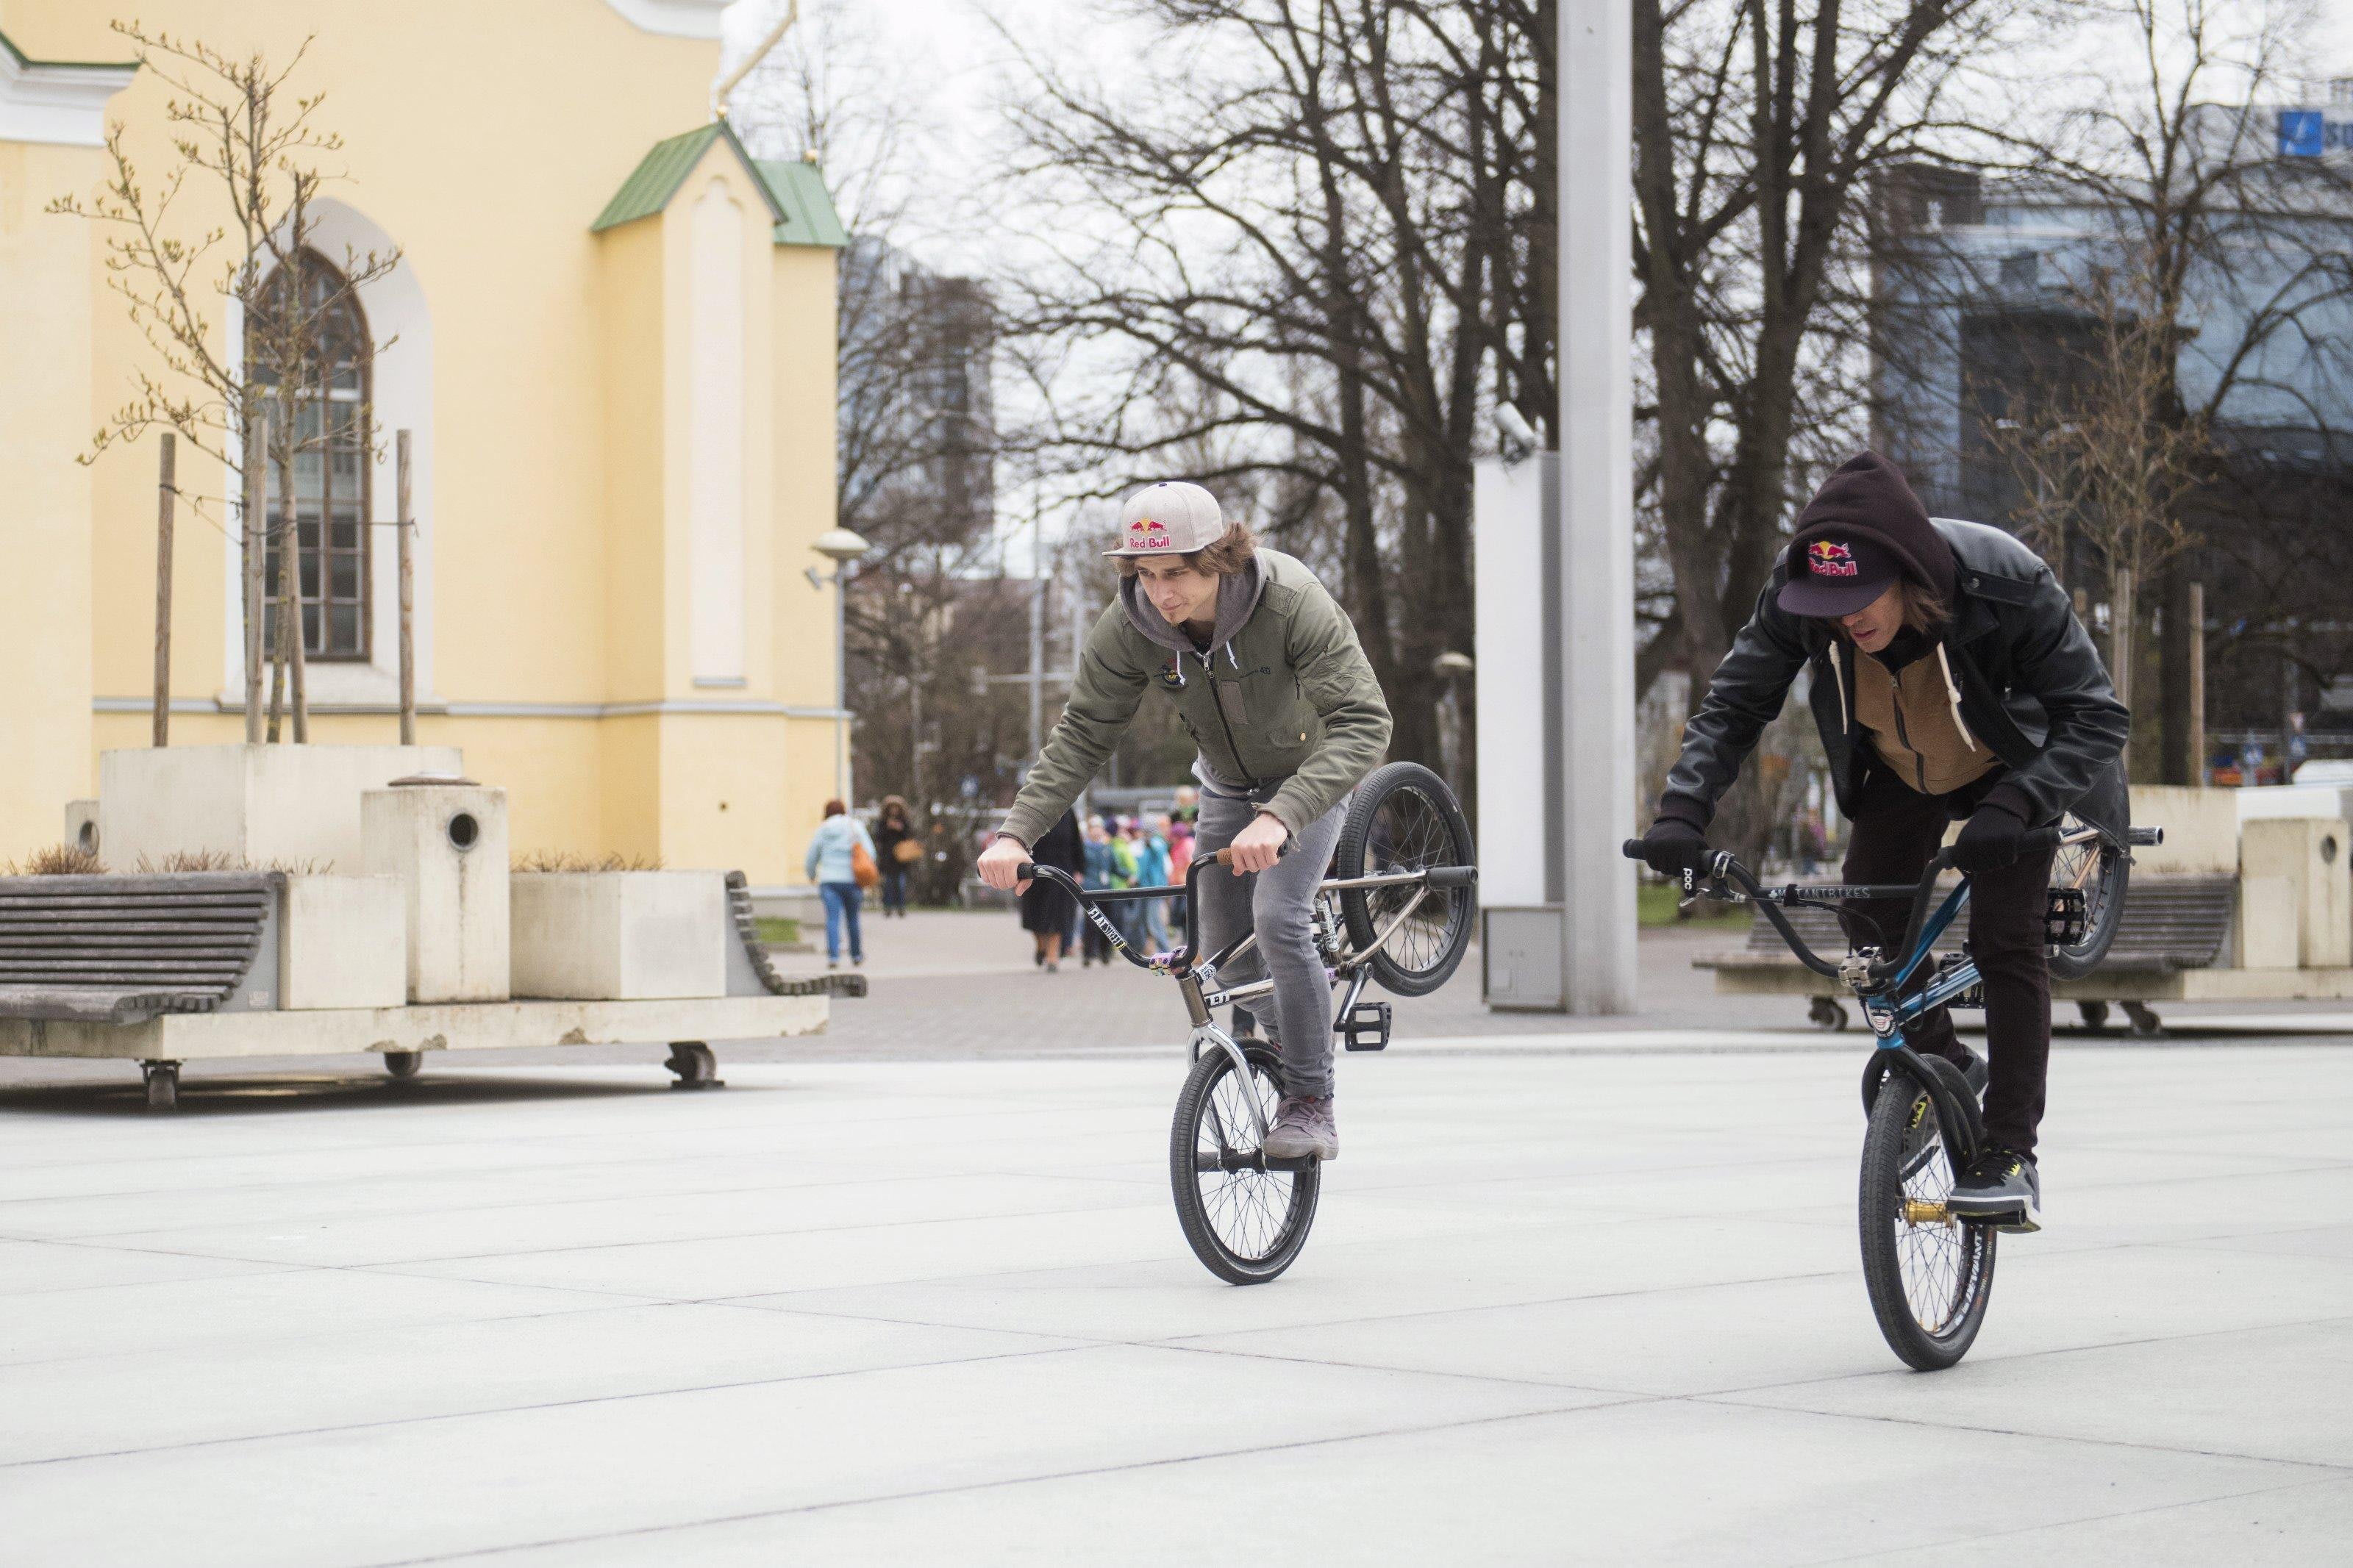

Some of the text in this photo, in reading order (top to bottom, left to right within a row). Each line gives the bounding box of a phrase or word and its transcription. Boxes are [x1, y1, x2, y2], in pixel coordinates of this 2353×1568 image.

[1129, 535, 1170, 548] Red Bull
[1827, 561, 1857, 576] Bull
[1778, 887, 1870, 898] MTANTBIKES
